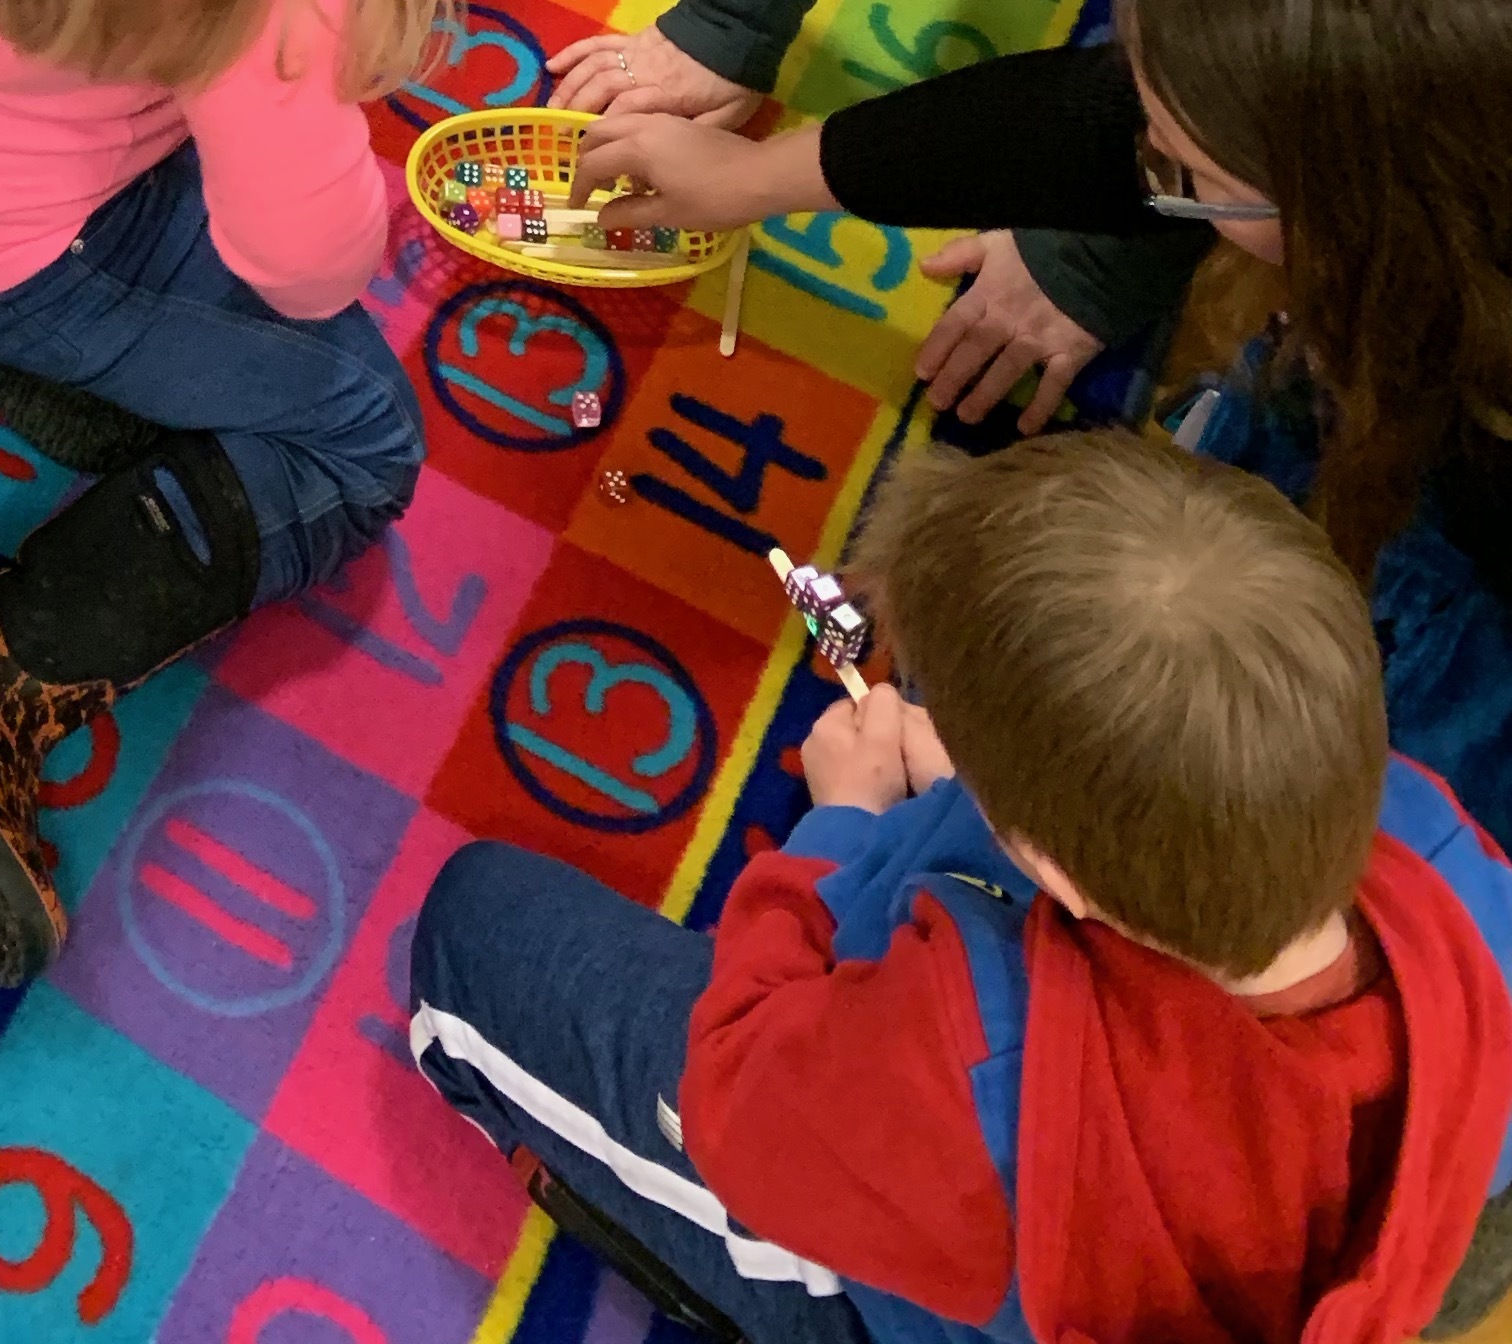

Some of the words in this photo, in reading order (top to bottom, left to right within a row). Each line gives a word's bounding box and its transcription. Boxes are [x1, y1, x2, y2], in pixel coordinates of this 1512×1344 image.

[438, 298, 610, 438] 13
[628, 392, 828, 555] 14
[505, 643, 697, 814] 13
[140, 817, 317, 969] 11
